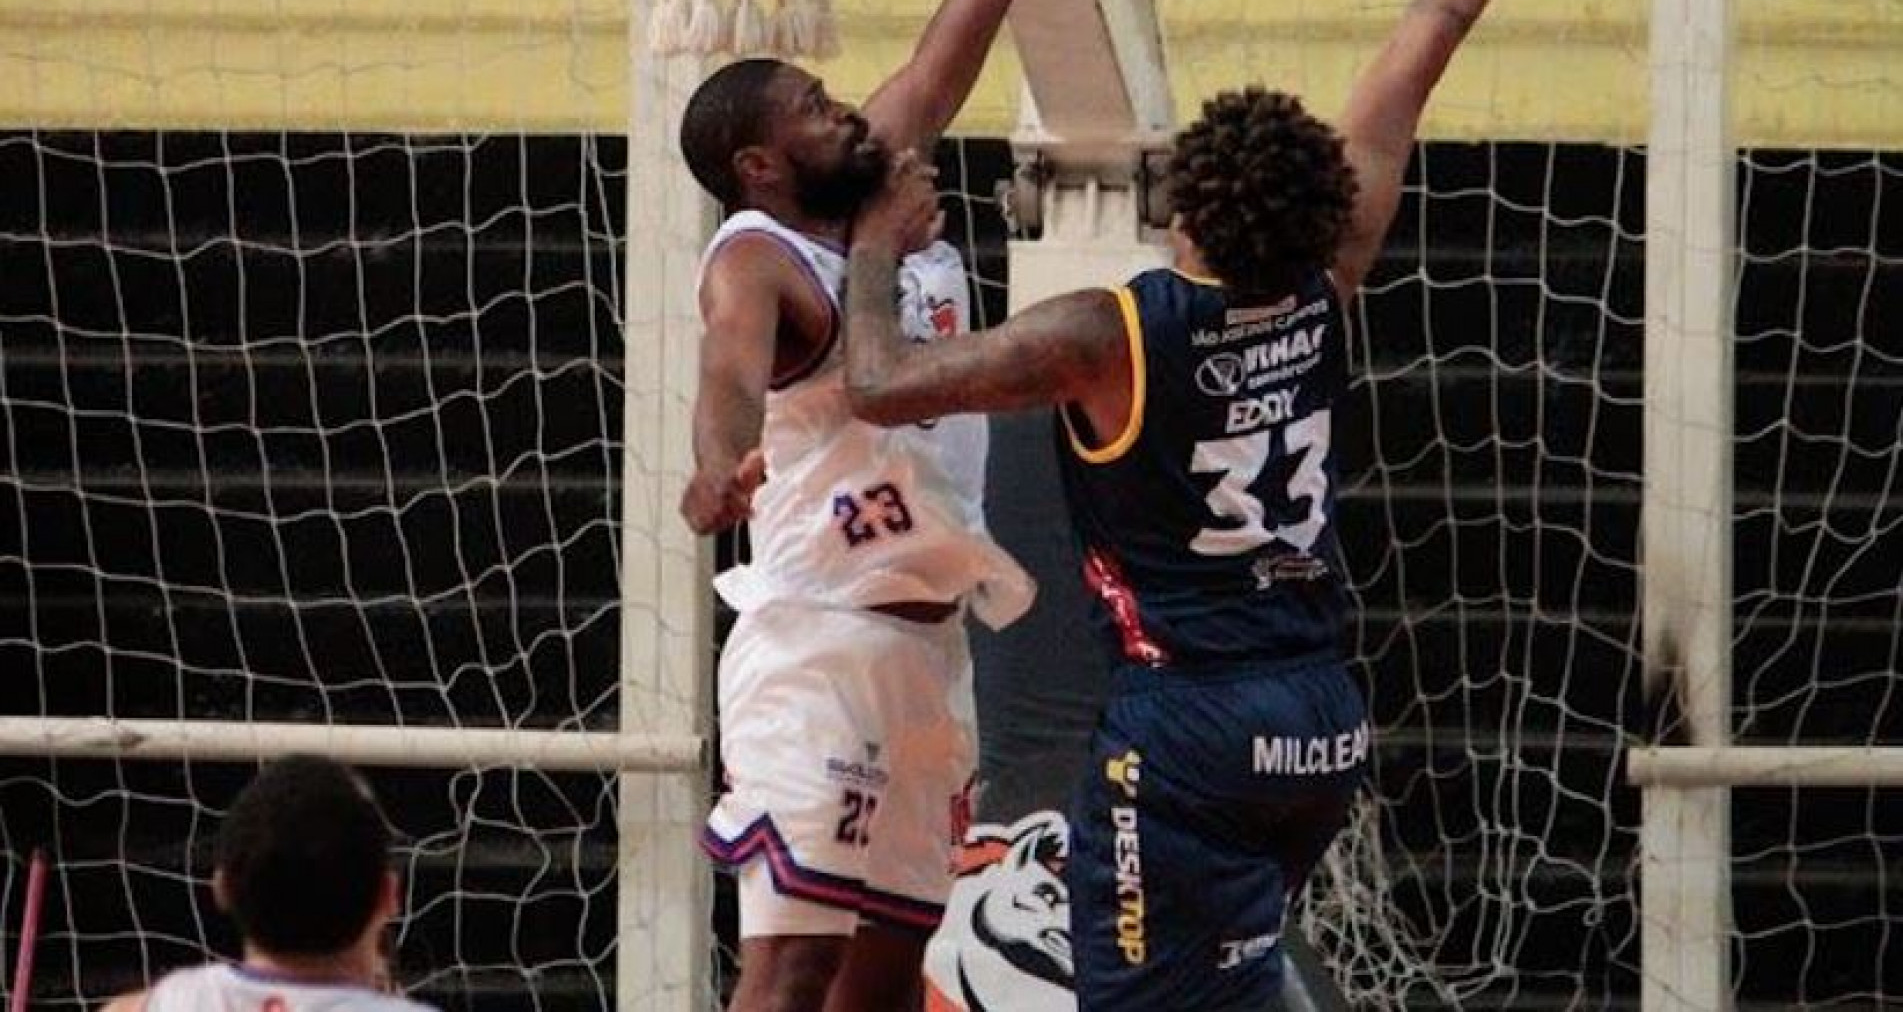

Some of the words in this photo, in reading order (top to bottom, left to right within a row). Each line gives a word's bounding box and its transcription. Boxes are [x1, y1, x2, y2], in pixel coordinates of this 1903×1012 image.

[833, 483, 912, 546] 23
[1188, 408, 1332, 555] 33
[1253, 721, 1370, 776] MILCLEA
[1111, 806, 1147, 965] DESKTOP
